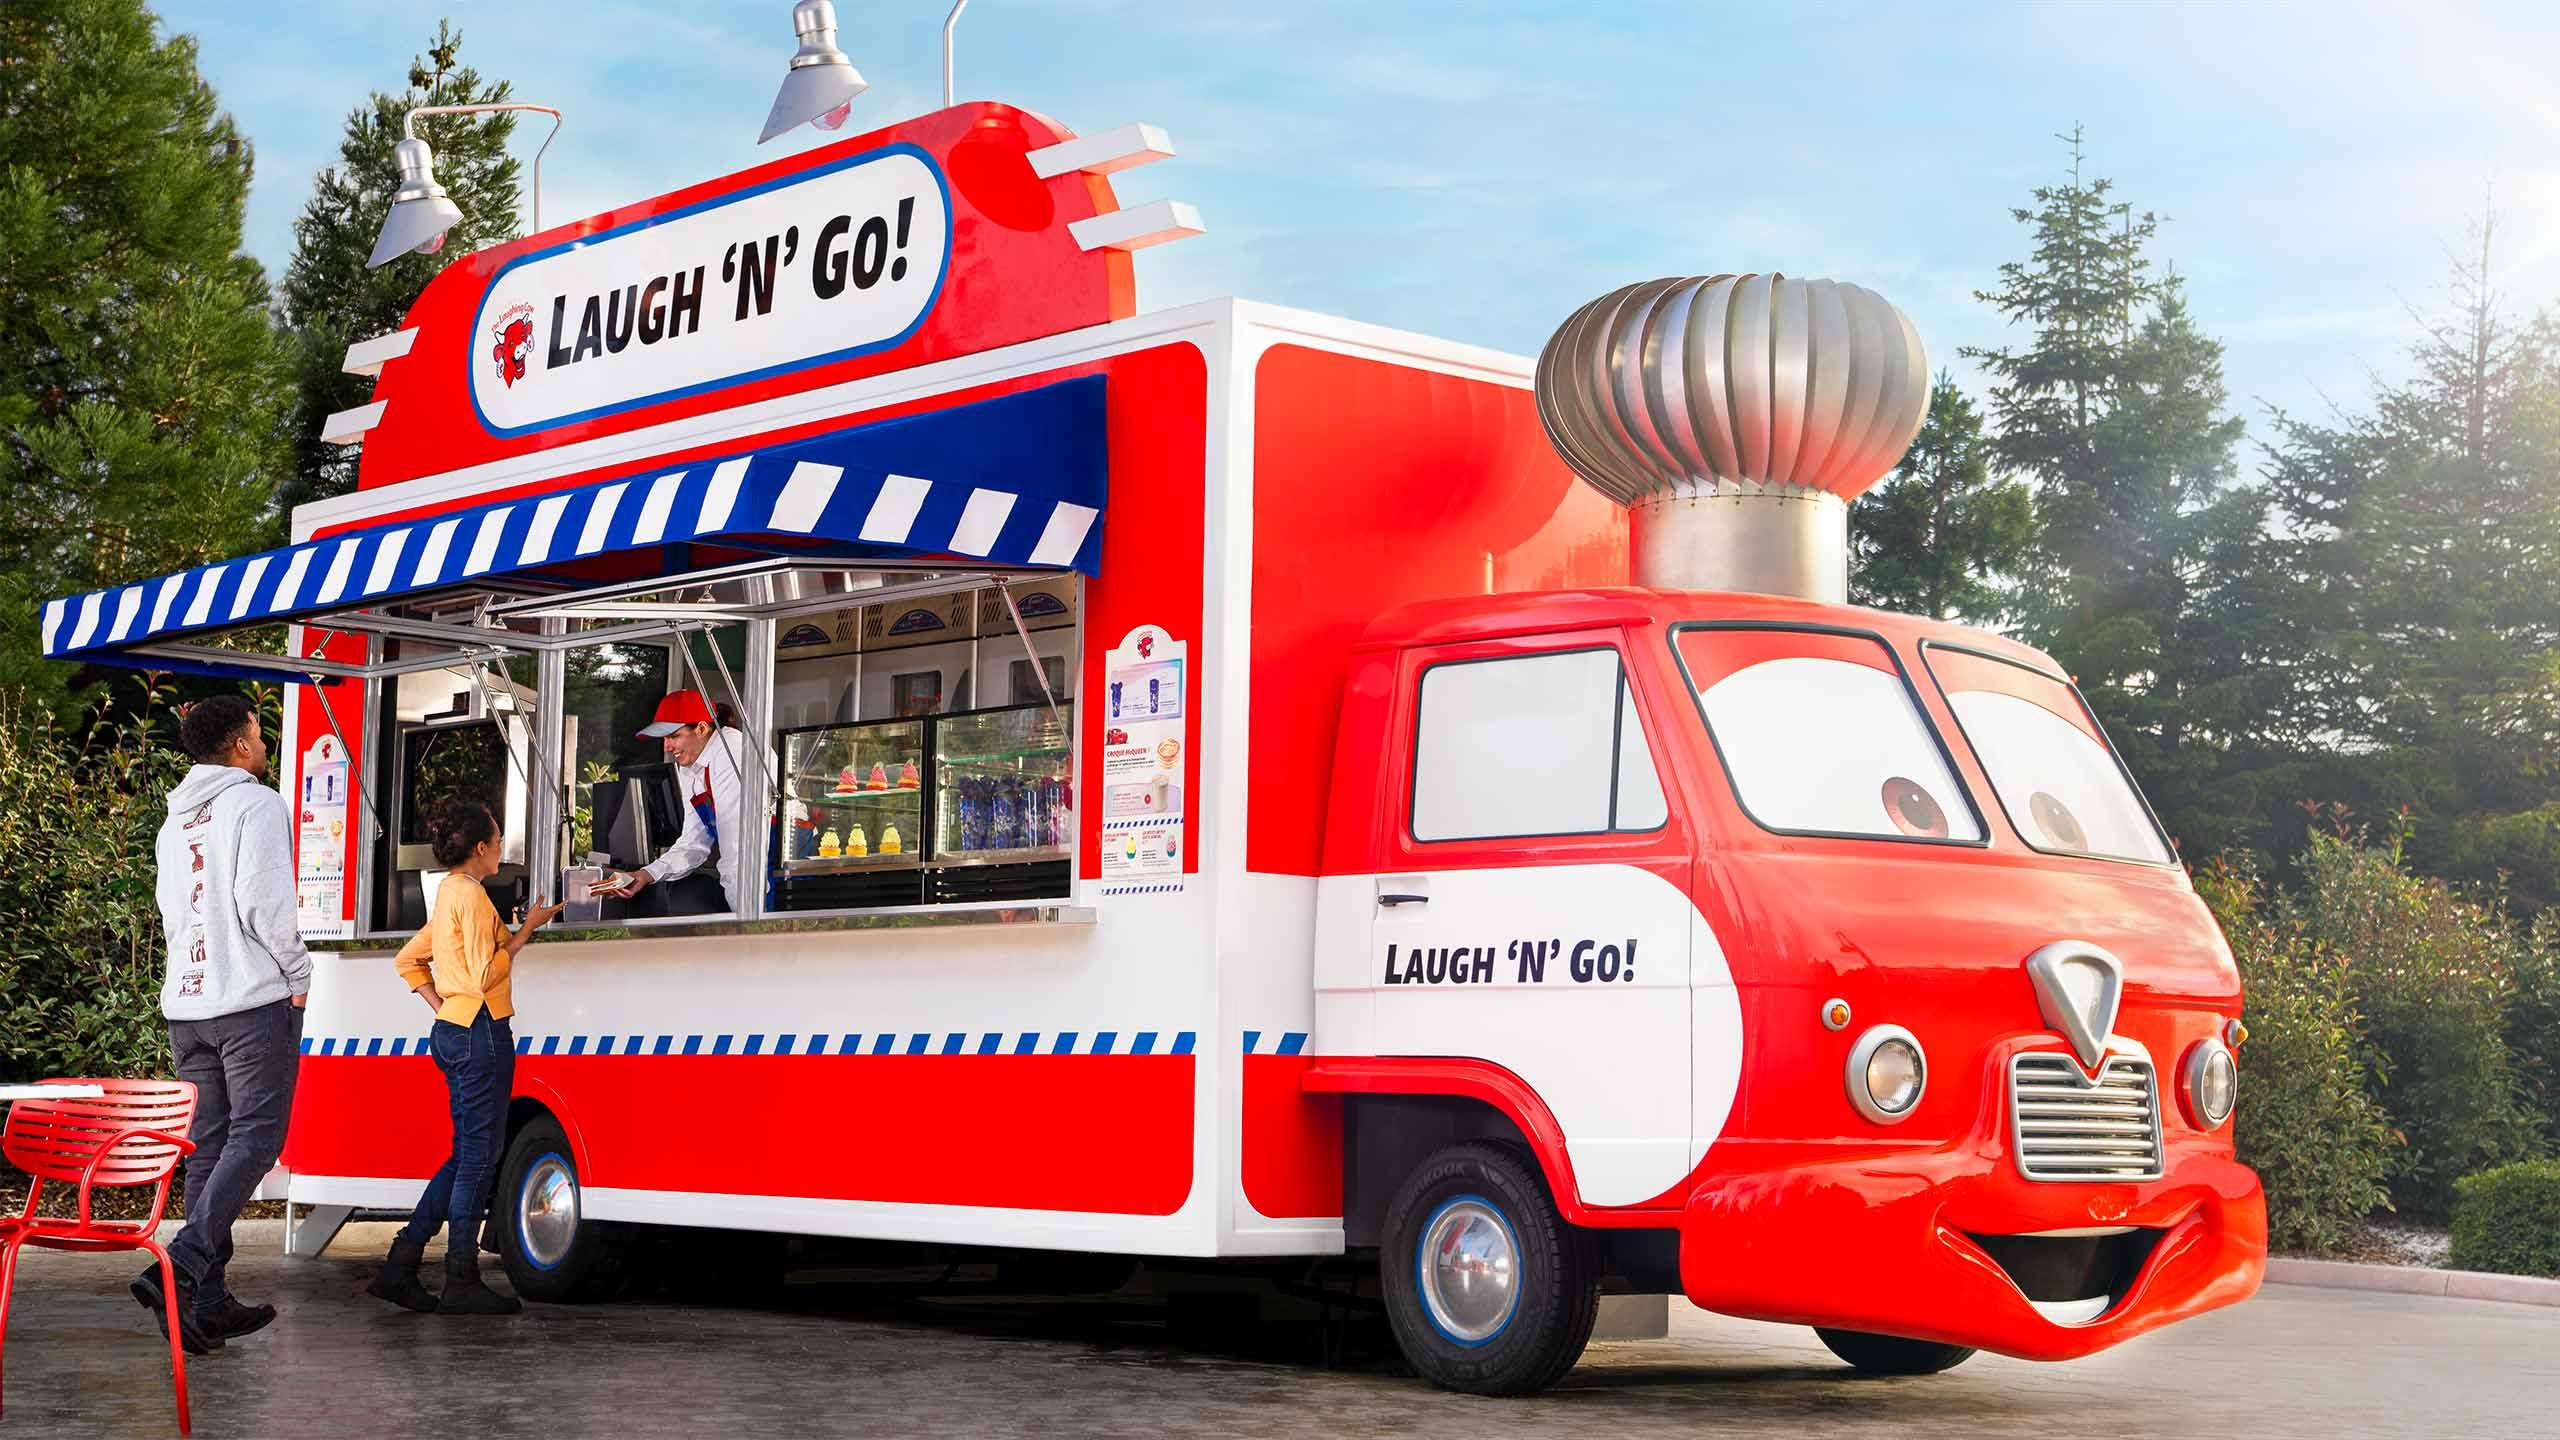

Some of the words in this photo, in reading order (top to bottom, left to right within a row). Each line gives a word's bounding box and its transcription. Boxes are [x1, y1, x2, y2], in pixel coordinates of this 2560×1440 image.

[547, 265, 705, 370] LAUGH
[811, 195, 915, 300] GO!
[1384, 944, 1496, 984] LAUGH
[1570, 938, 1637, 983] GO!
